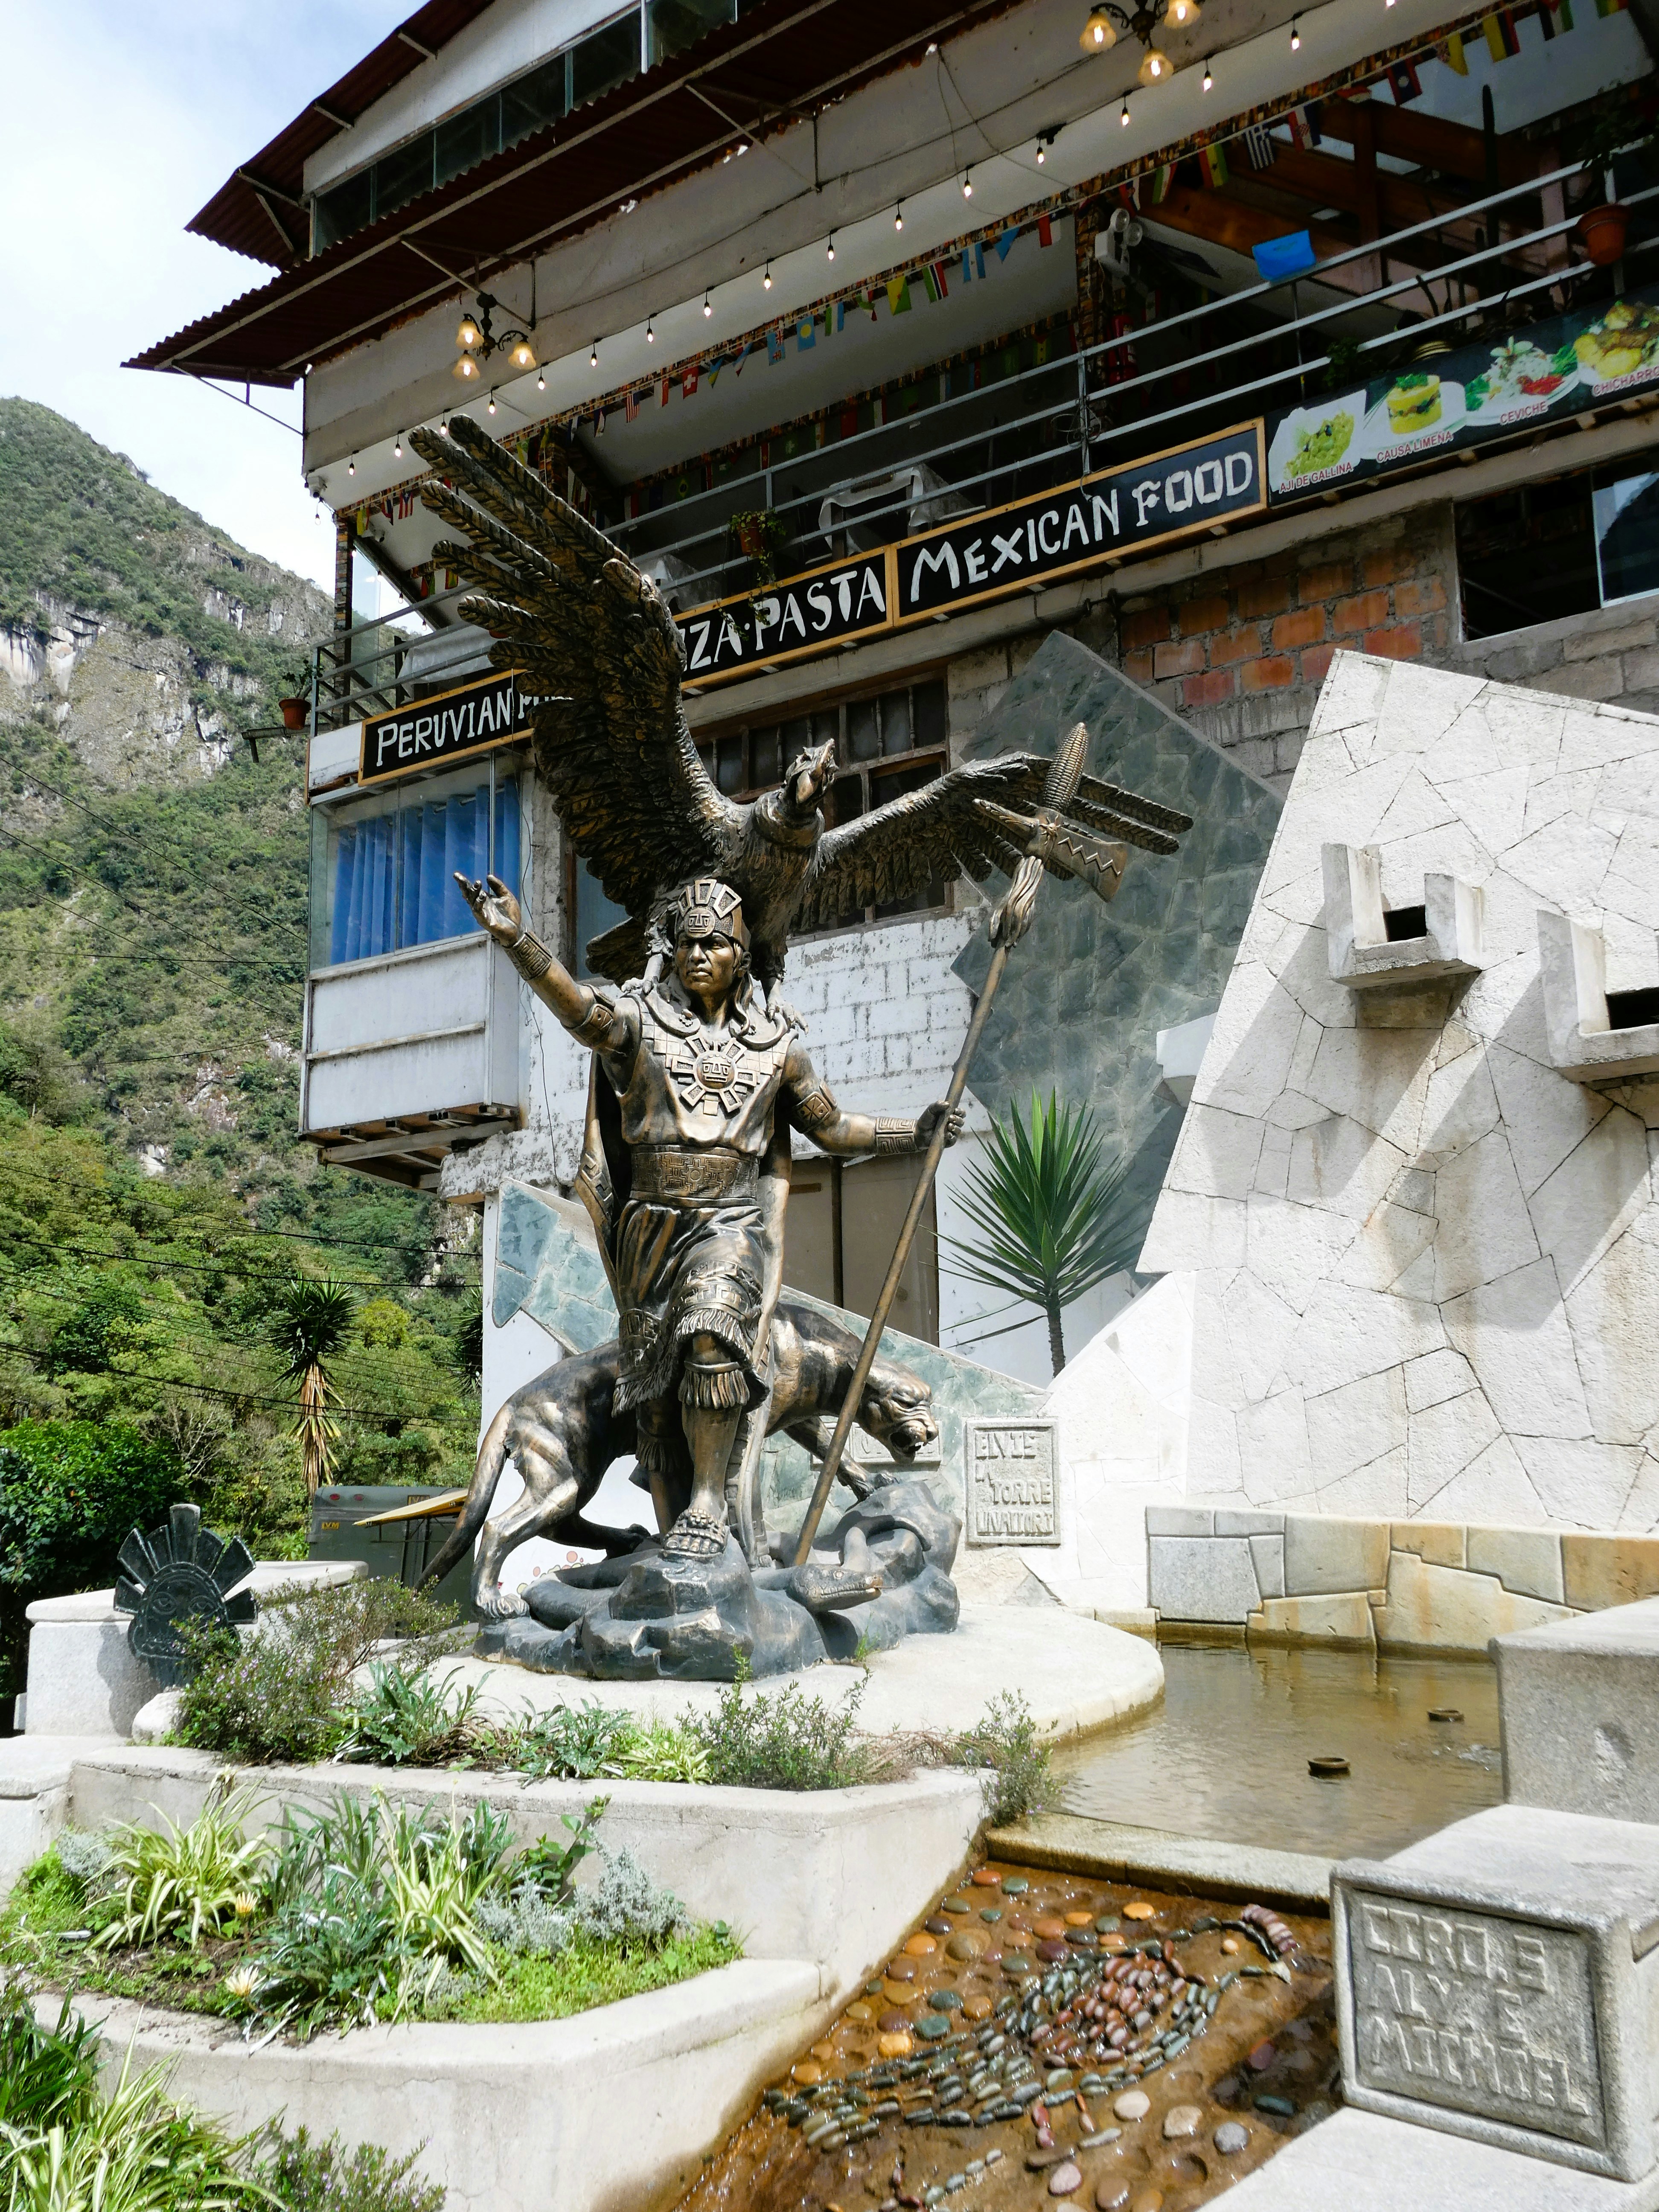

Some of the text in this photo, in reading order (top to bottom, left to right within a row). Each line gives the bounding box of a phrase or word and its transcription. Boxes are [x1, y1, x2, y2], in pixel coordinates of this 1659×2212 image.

[1500, 401, 1546, 423] CEVICHE
[1377, 442, 1411, 462] CAUSA
[1280, 462, 1353, 492] AJI DE GALLINA
[911, 451, 1253, 602] MEXICAN FOOD
[376, 687, 512, 767] PERUVIAN
[989, 1479, 1052, 1505] TORRE
